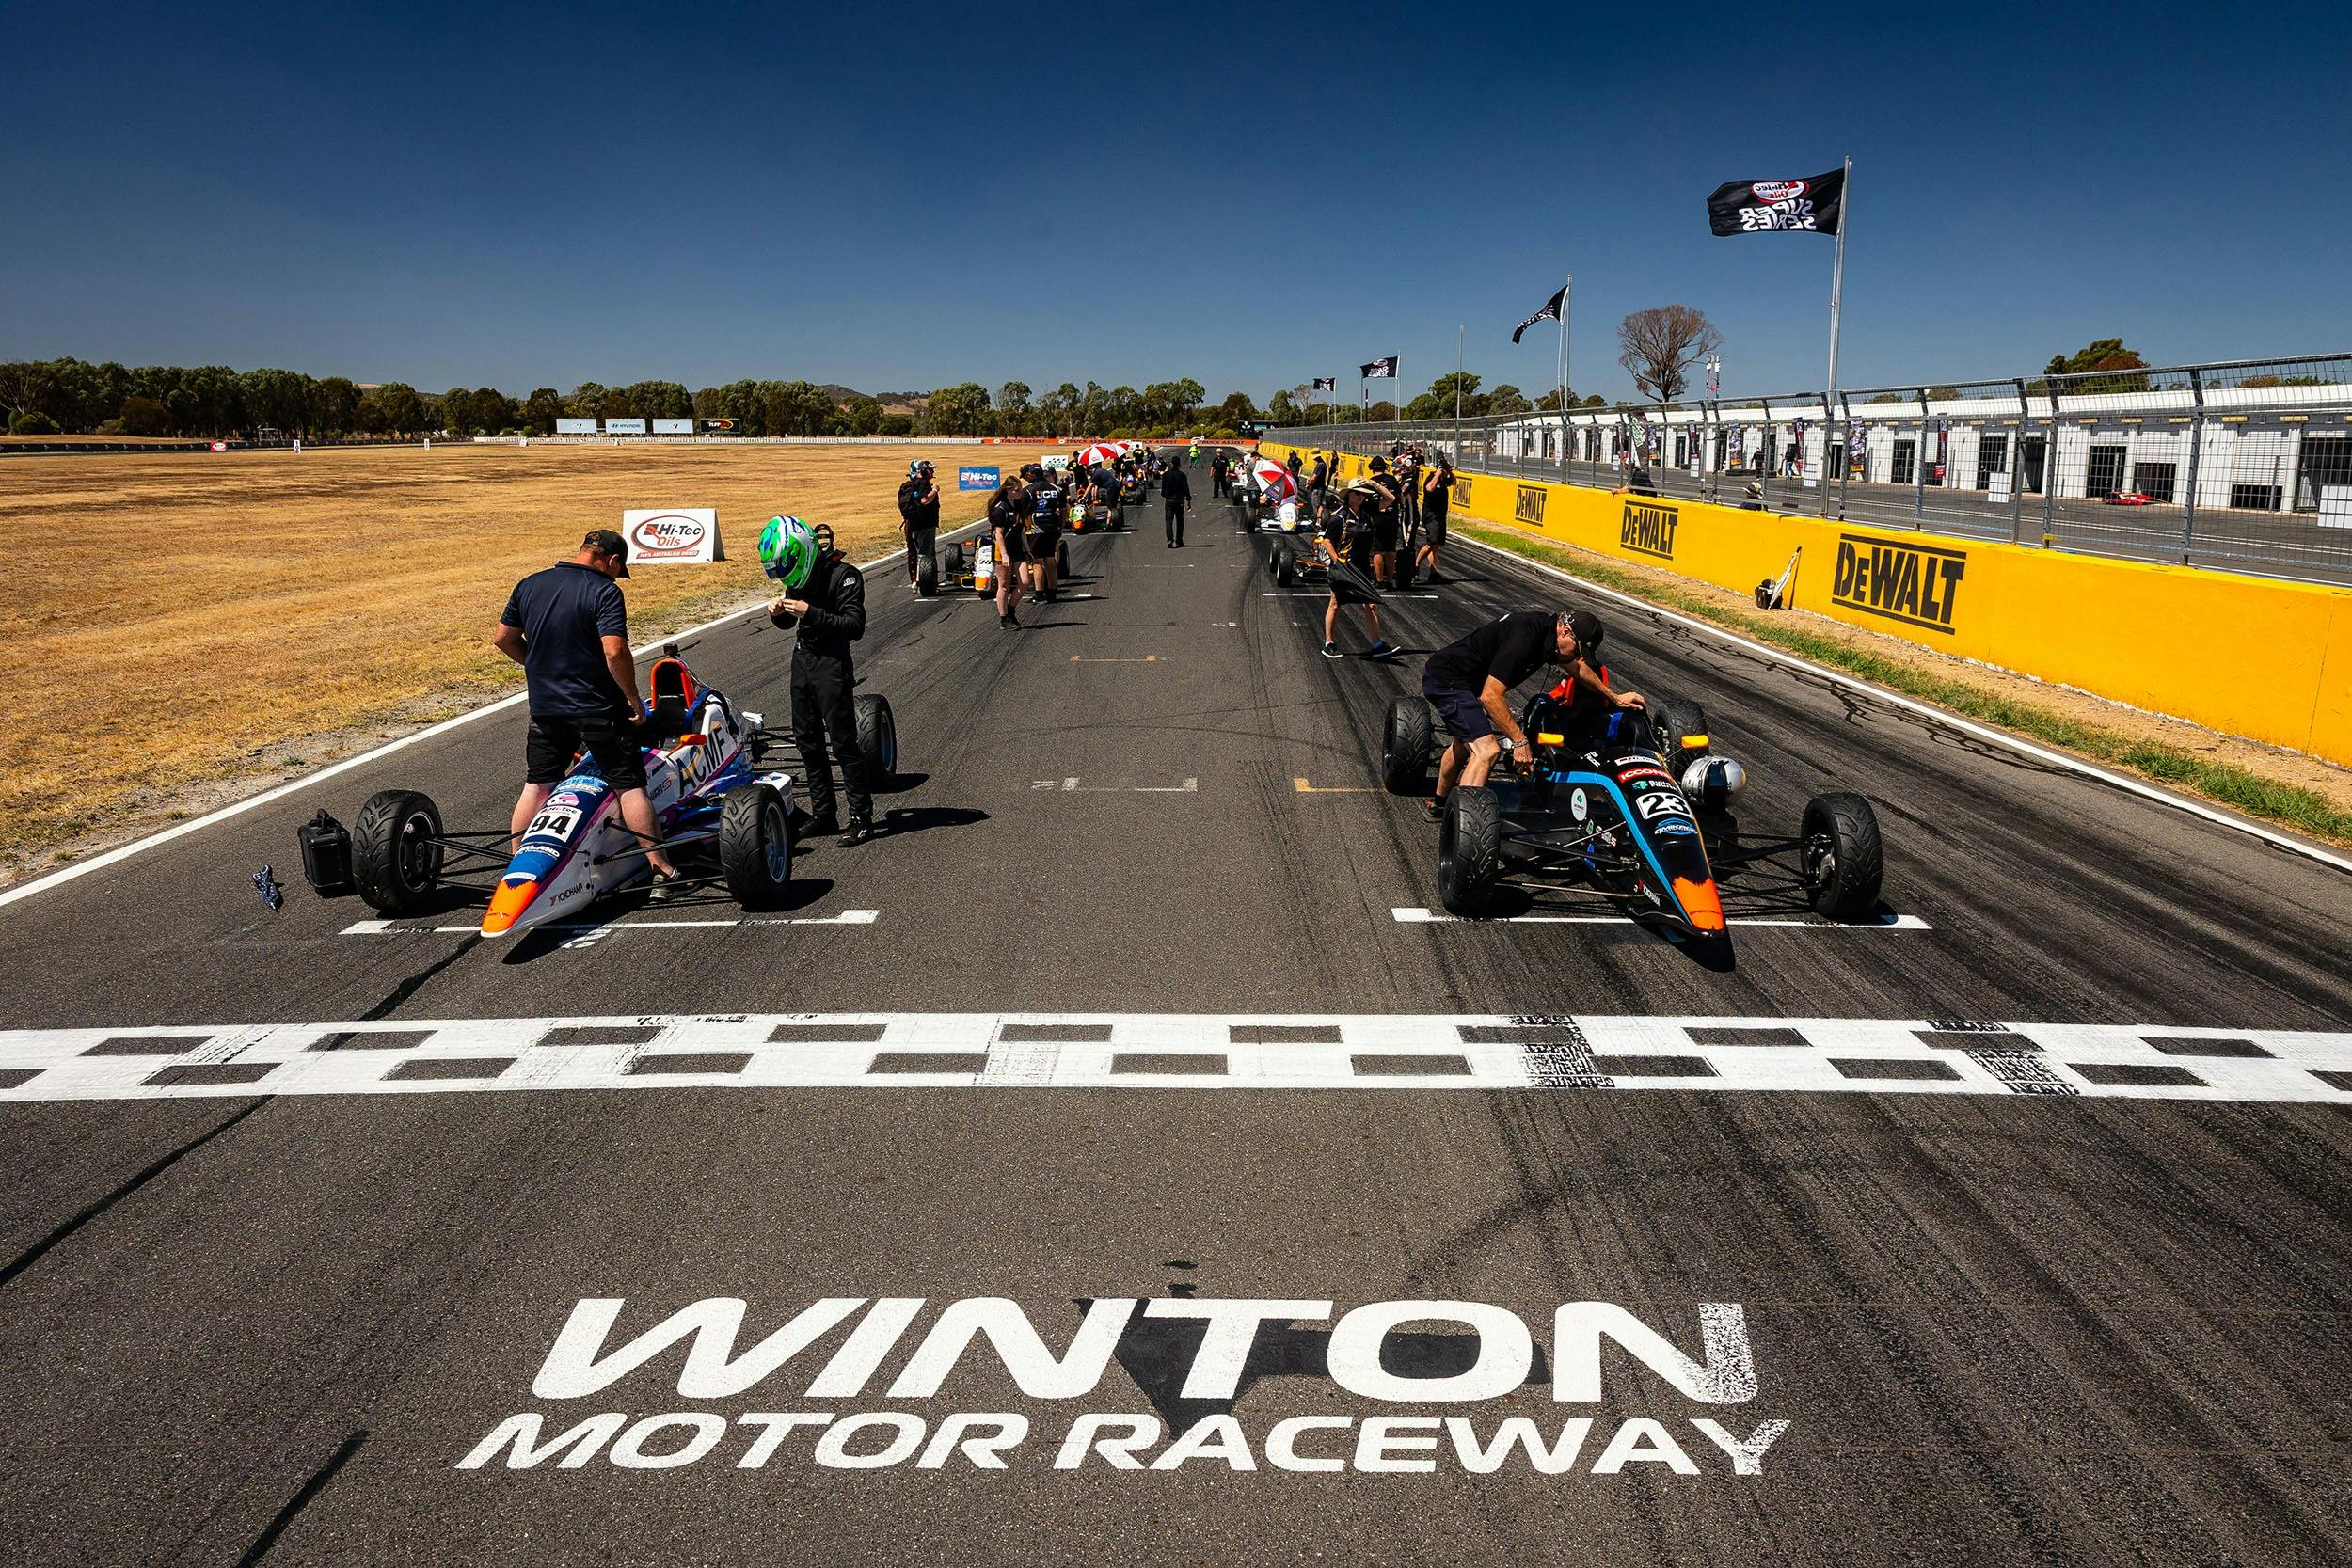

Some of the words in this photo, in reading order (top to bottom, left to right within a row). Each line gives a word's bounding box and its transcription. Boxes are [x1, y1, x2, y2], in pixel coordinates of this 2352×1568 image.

[1036, 490, 1058, 499] JCB
[659, 523, 702, 535] Hi-Tec
[657, 536, 681, 546] Oils
[1642, 794, 1690, 816] 23
[528, 815, 572, 836] 94
[531, 1295, 1759, 1402] WINTON
[454, 1411, 1030, 1472] MOTOR
[1052, 1413, 1791, 1478] RACEWAY
